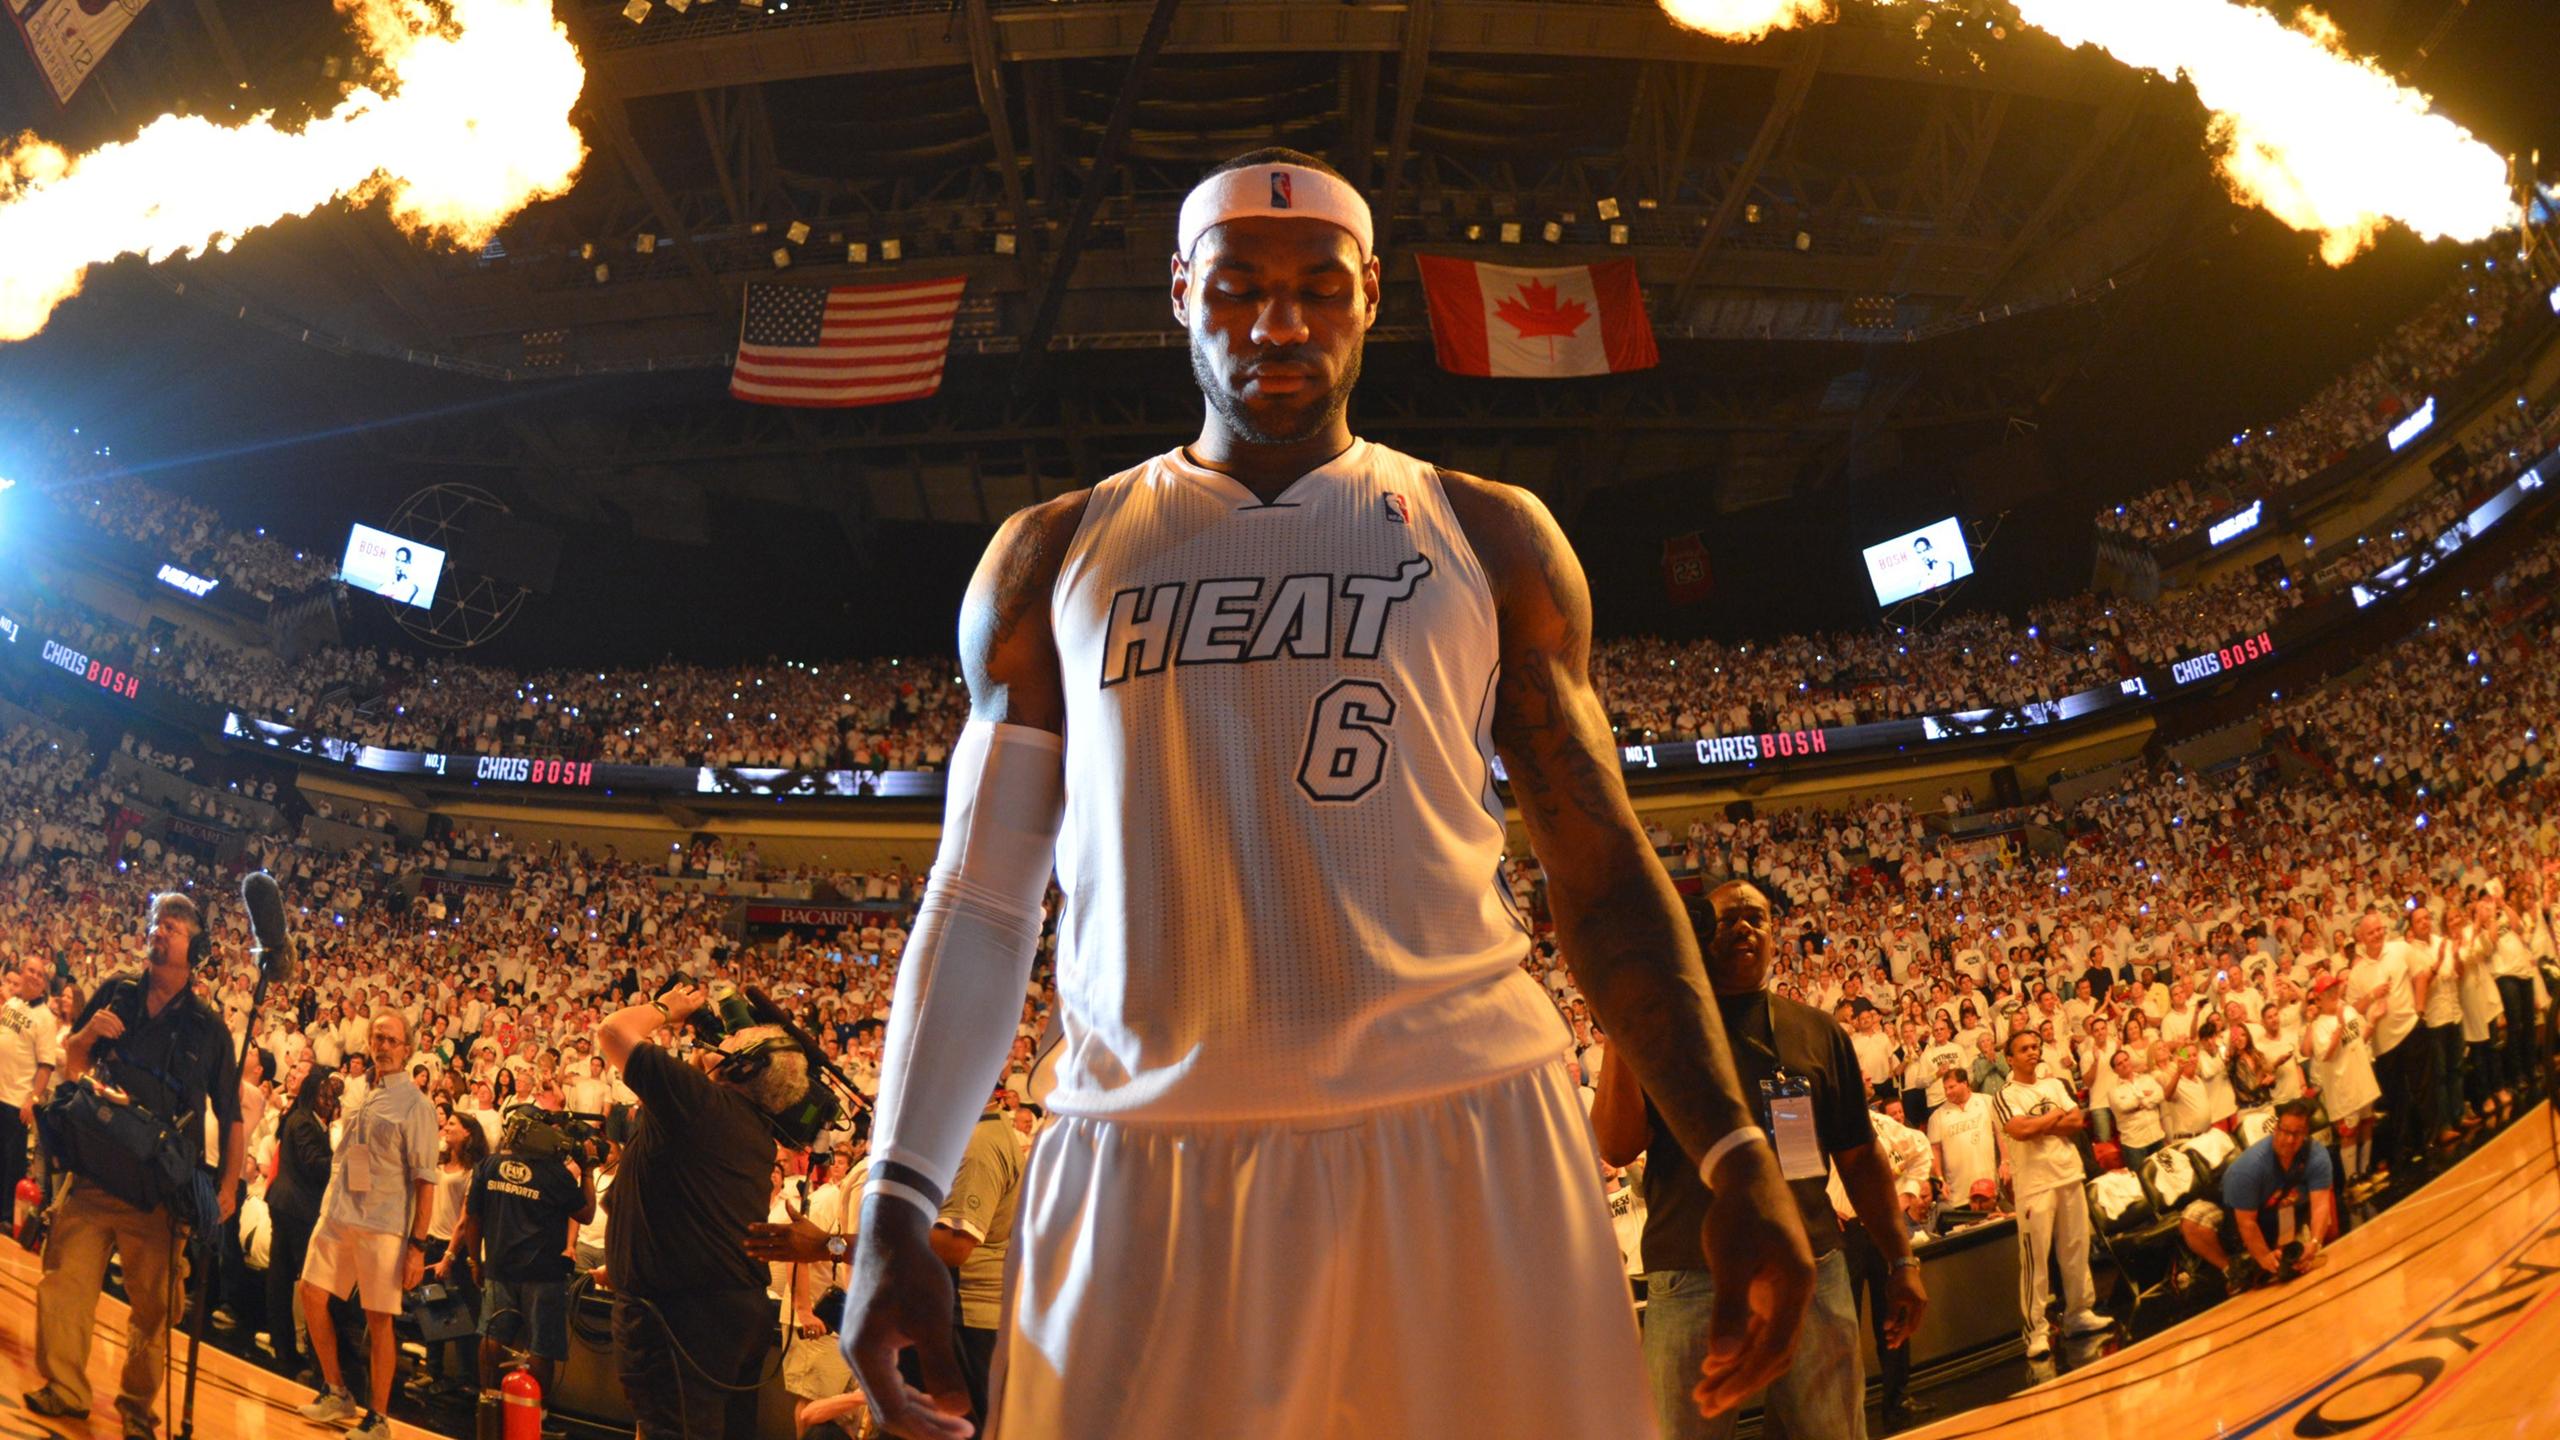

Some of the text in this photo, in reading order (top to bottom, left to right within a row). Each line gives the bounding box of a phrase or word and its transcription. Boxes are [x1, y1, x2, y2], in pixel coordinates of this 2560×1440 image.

[70, 40, 94, 74] 12
[359, 540, 386, 559] BOSH
[1878, 551, 1908, 570] BOSH
[1100, 553, 1432, 689] HEAT
[42, 640, 88, 675] CHRIS
[87, 660, 139, 699] BOSH
[2120, 632, 2273, 696] NO.1 CHRIS BOSH
[1297, 679, 1397, 802] 6
[1625, 729, 1827, 768] NO.1 CHRIS BOSH
[425, 753, 593, 786] NO.1 CHRIS BOSH
[781, 908, 863, 927] BACARDI
